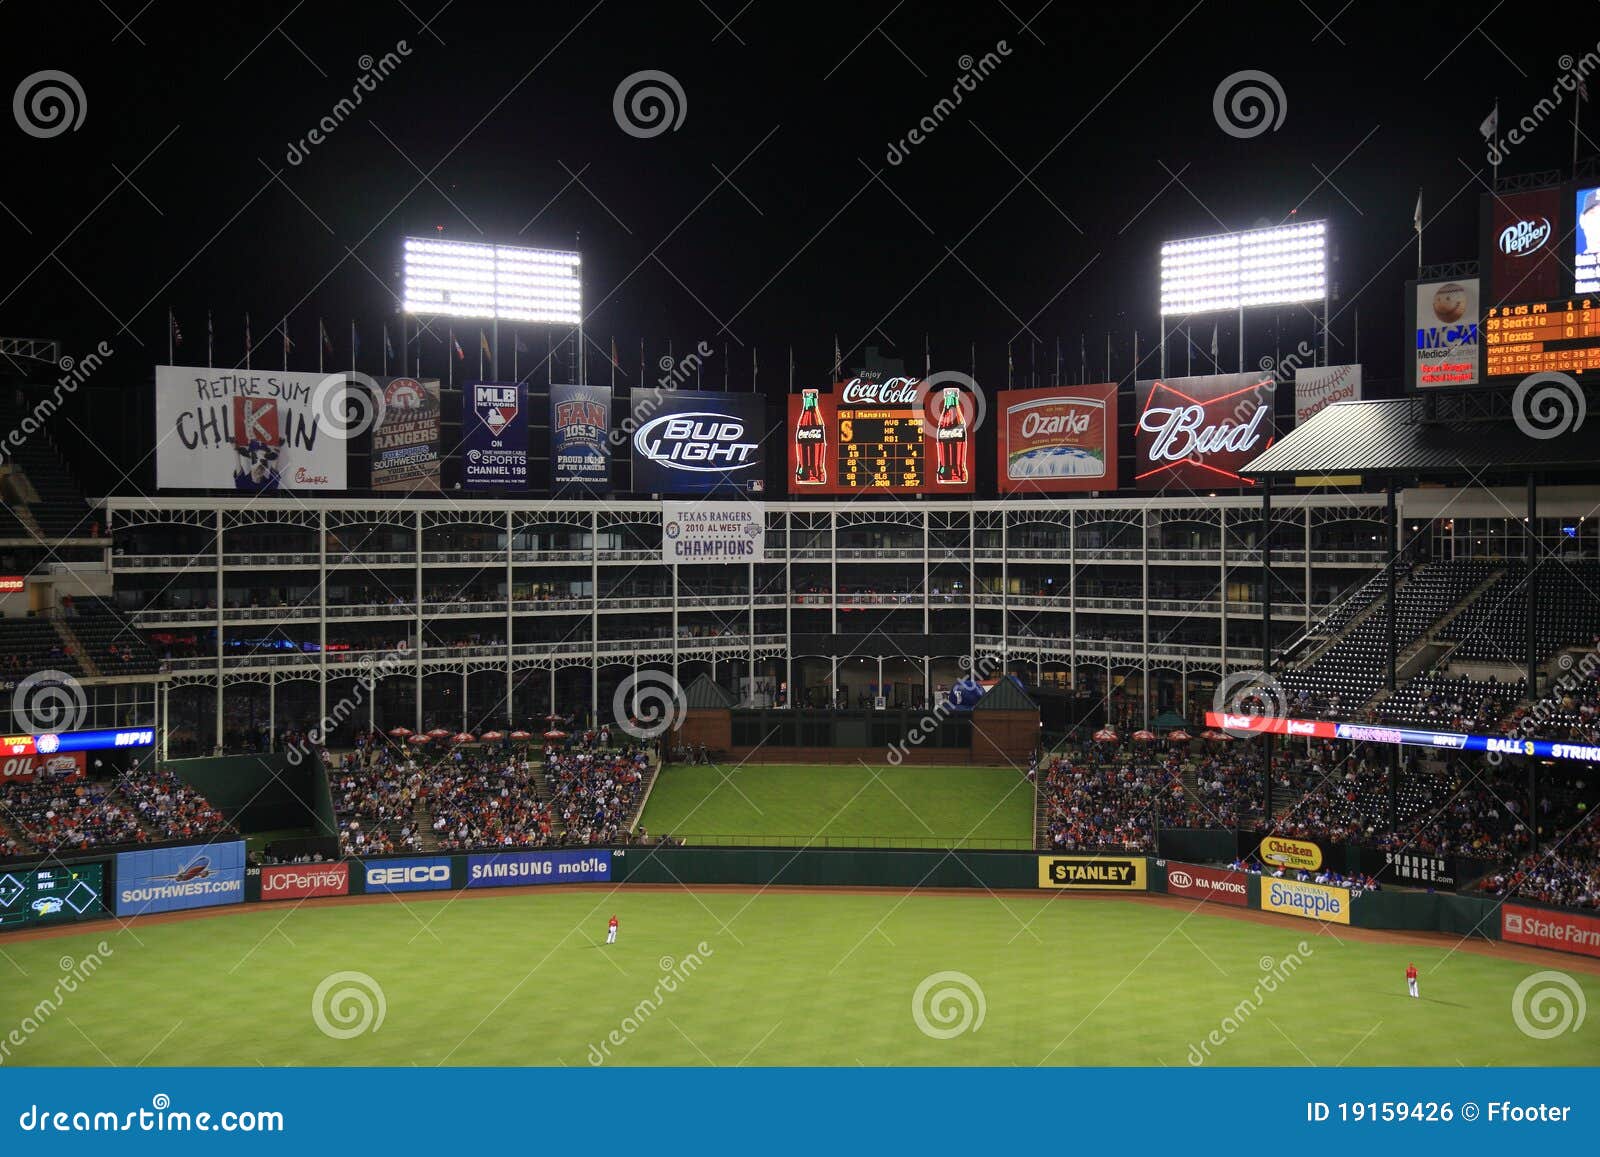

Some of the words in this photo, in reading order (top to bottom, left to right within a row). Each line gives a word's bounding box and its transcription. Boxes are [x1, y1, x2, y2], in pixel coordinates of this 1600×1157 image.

[1517, 221, 1535, 237] Dr
[1499, 225, 1547, 255] Pepper
[1502, 305, 1528, 316] 8:05
[1533, 304, 1547, 313] PM
[1567, 301, 1573, 310] 1
[1582, 300, 1591, 309] 2
[1487, 319, 1500, 330] 39
[1502, 316, 1547, 329] Seattle
[1566, 312, 1574, 323] 0
[1582, 311, 1591, 321] 2
[1487, 333, 1500, 343] 36
[1502, 332, 1535, 342] Texas
[1566, 326, 1574, 337] 0
[860, 371, 882, 379] Enjoy
[195, 375, 261, 400] RETIRE
[268, 378, 310, 404] SUM
[477, 387, 515, 403] MLB
[843, 377, 920, 404] Coca-Cola
[1297, 384, 1354, 420] SportsDay
[558, 402, 605, 430] FAN
[1022, 409, 1090, 438] Ozarka
[375, 422, 415, 436] FOLLOW
[418, 420, 436, 430] THE
[566, 425, 596, 438] 105.3
[664, 420, 745, 440] BUD
[1140, 404, 1268, 461] Bud
[374, 429, 438, 449] RANGERS
[557, 455, 583, 464] PROUD
[648, 440, 758, 461] LIGHT
[374, 452, 437, 470] SOUTHWEST.COM
[482, 456, 527, 465] SPORTS
[467, 466, 510, 475] CHANNEL
[512, 467, 527, 475] 198
[678, 512, 707, 521] TEXAS
[710, 512, 752, 521] RANGERS
[686, 524, 704, 532] 2010
[708, 524, 718, 532] AL
[720, 524, 742, 532] WEST
[675, 540, 754, 556] CHAMPIONS
[3, 736, 33, 746] TOTAL
[115, 731, 153, 746] MPH
[1486, 738, 1523, 754] BALL
[1525, 741, 1535, 756] 3
[3, 757, 34, 776] OIL
[1269, 841, 1313, 857] Chicken
[472, 861, 552, 879] SAMSUNG
[1386, 853, 1445, 872] SHARPER
[263, 873, 346, 891] JCPenney
[367, 866, 450, 885] GEICO
[1055, 865, 1130, 881] STANLEY
[1172, 873, 1189, 885] KIA
[121, 880, 241, 903] SOUTHWEST.COM
[1196, 878, 1210, 889] KIA
[1211, 881, 1246, 894] MOTORS
[1270, 883, 1340, 916] Snapple
